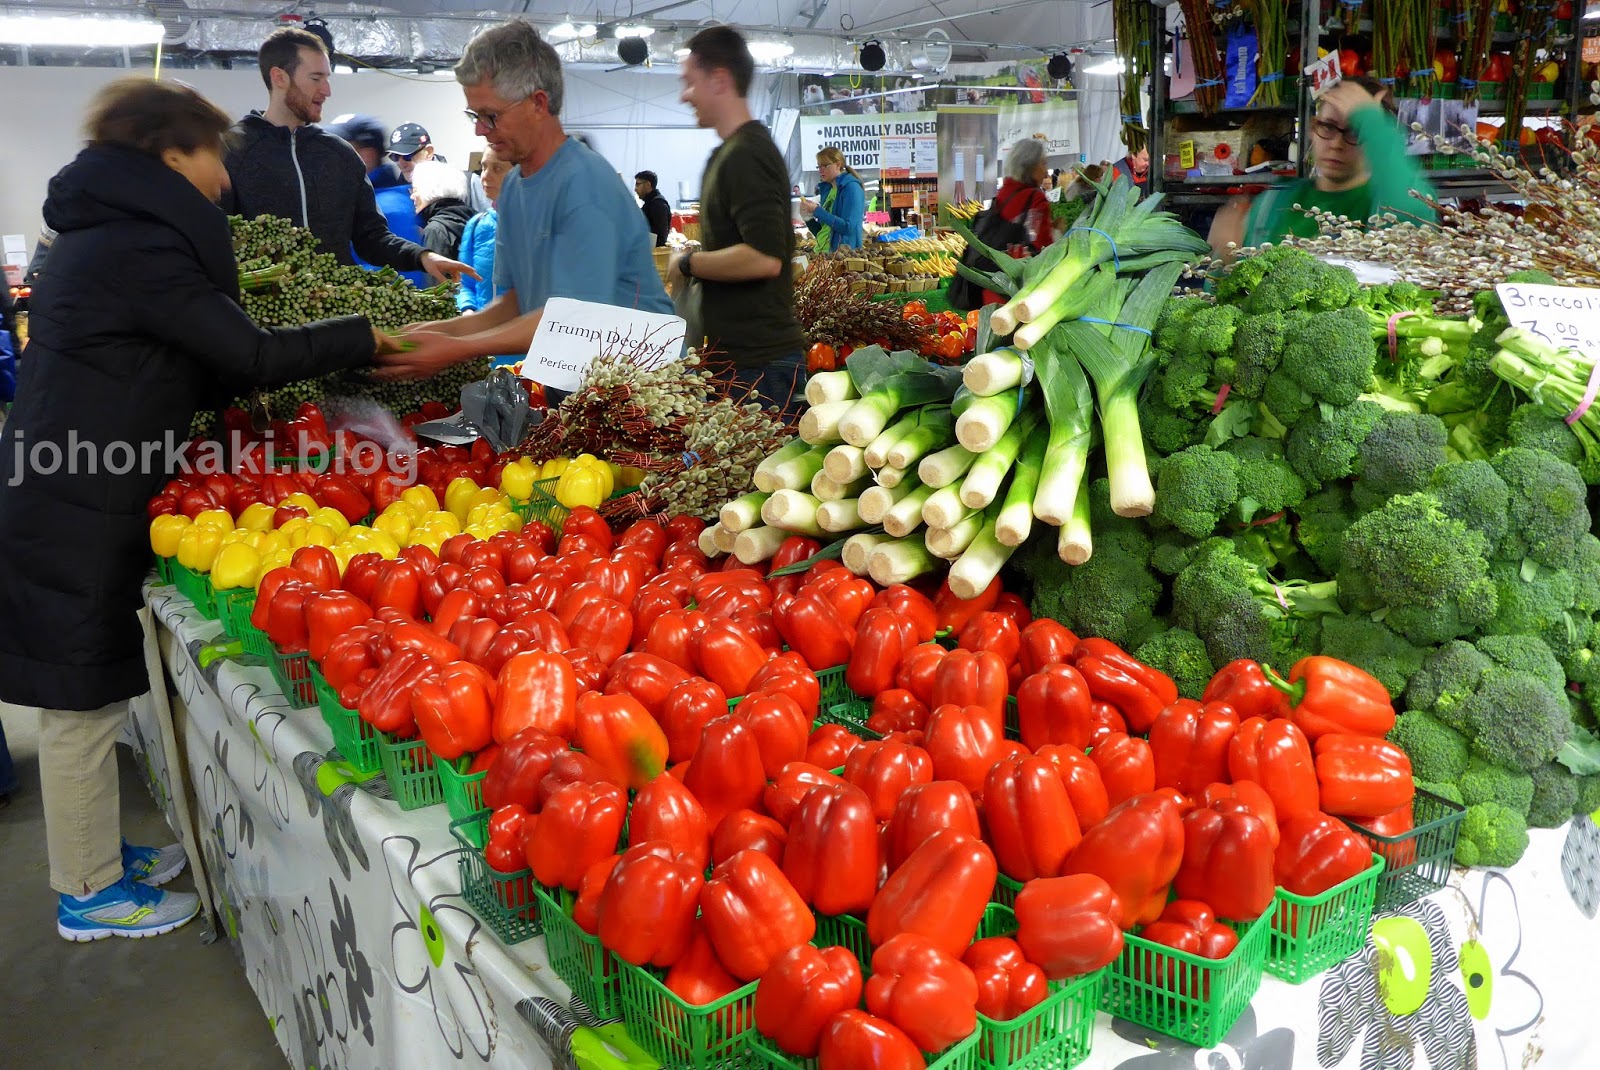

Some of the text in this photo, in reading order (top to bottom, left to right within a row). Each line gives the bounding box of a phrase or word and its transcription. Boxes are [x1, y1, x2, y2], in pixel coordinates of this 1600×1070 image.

[824, 121, 937, 138] NATURALLY RAISED
[548, 320, 601, 343] Trump
[540, 357, 577, 372] Perfect
